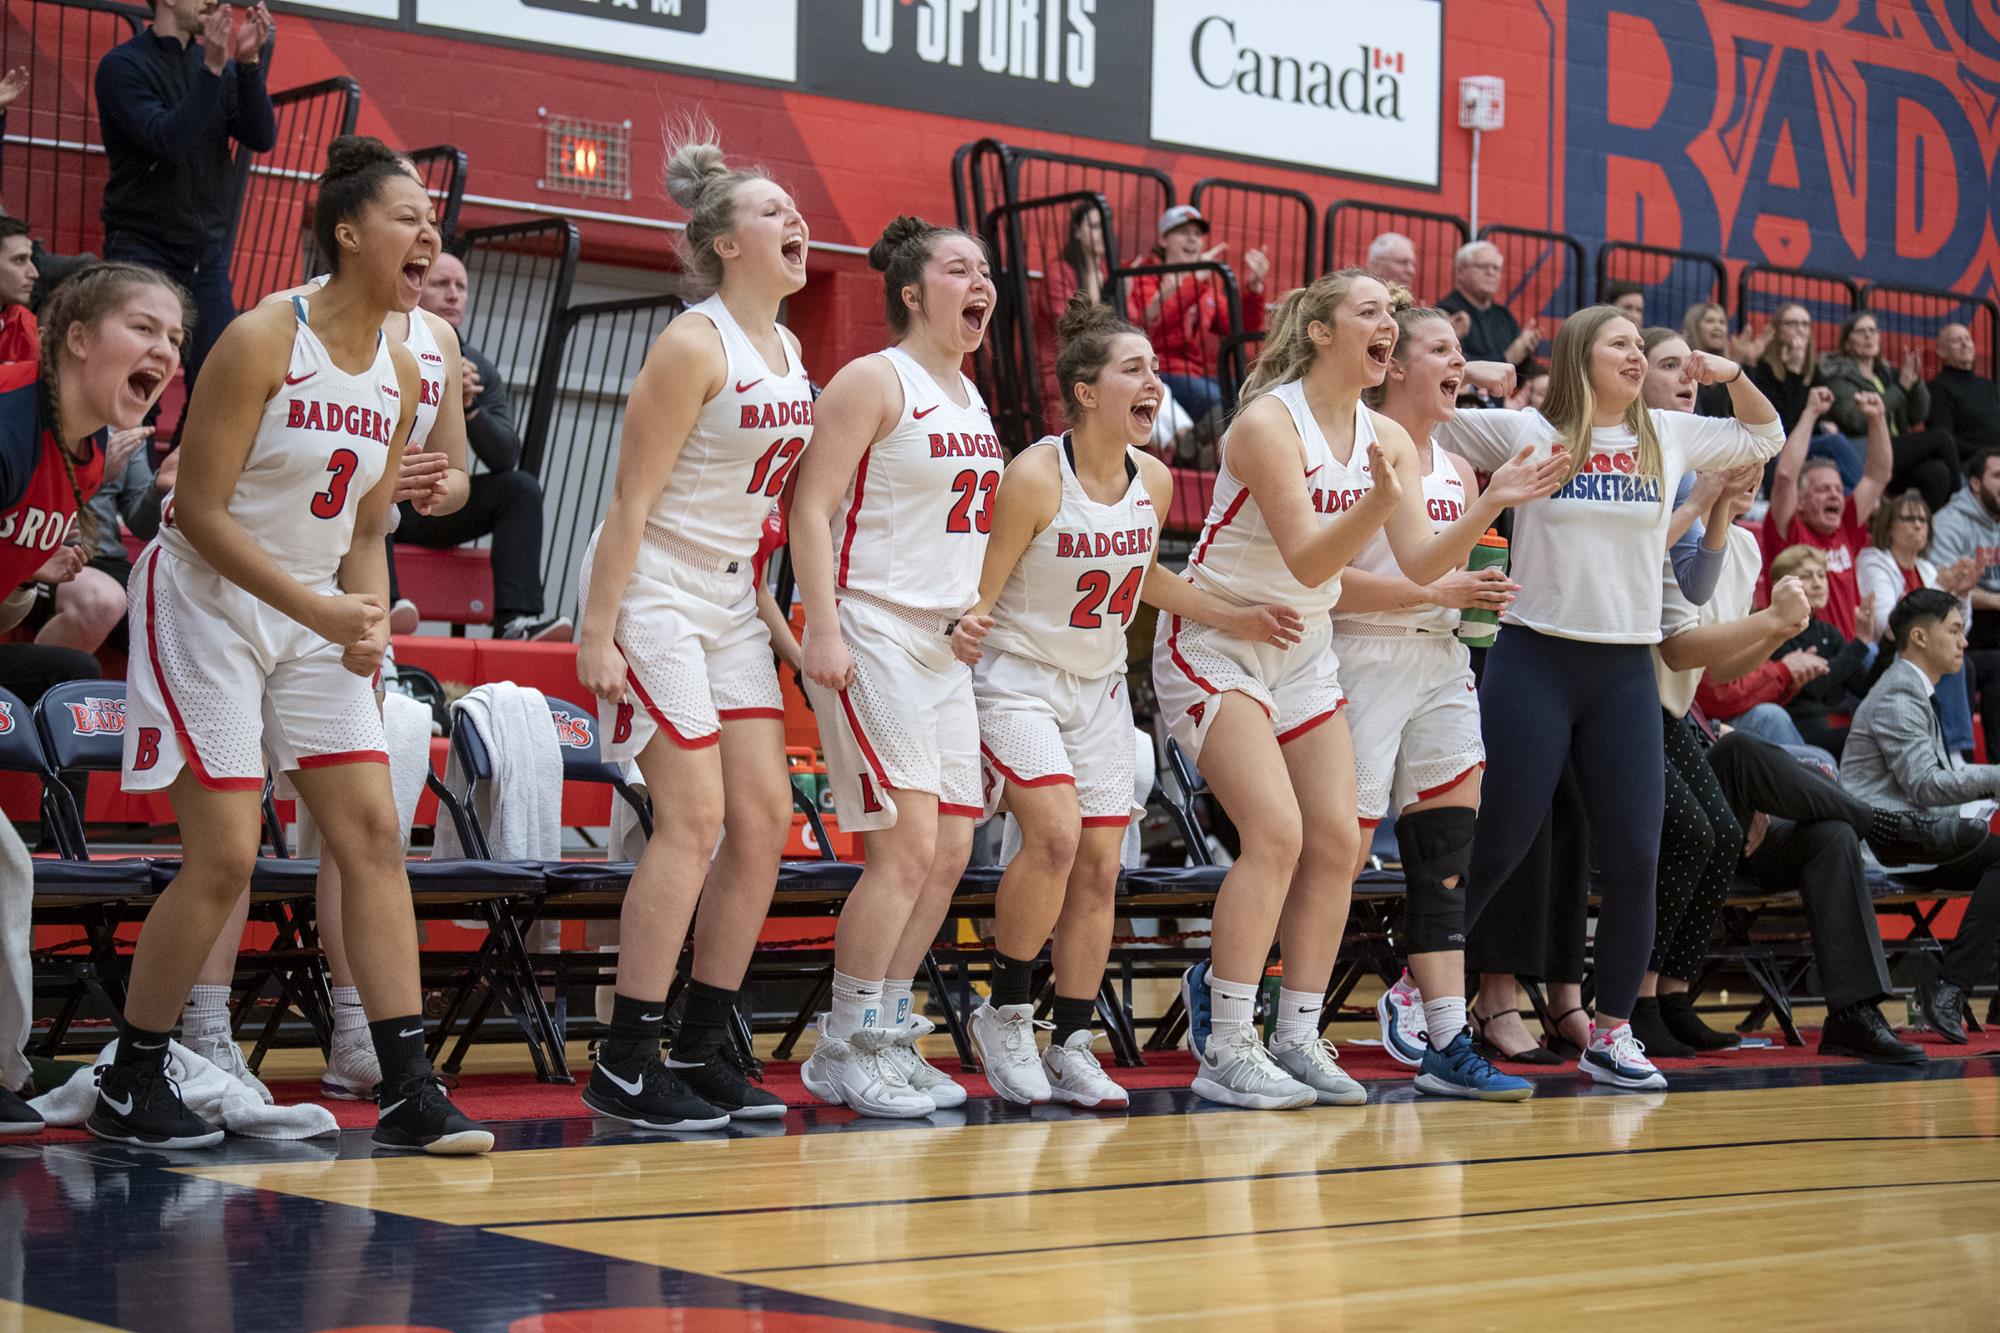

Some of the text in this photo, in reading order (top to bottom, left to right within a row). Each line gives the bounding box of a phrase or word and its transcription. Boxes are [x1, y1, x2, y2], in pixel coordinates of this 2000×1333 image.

[917, 0, 1097, 88] SPORTS
[1190, 15, 1405, 122] Canada
[1540, 0, 2000, 330] BAD
[286, 399, 391, 447] BADGERS
[310, 448, 359, 519] 3
[746, 437, 805, 497] 12
[946, 469, 1000, 534] 23
[1056, 526, 1152, 558] BADGERS
[1069, 565, 1144, 629] 24
[132, 727, 161, 771] B
[612, 703, 634, 744] B
